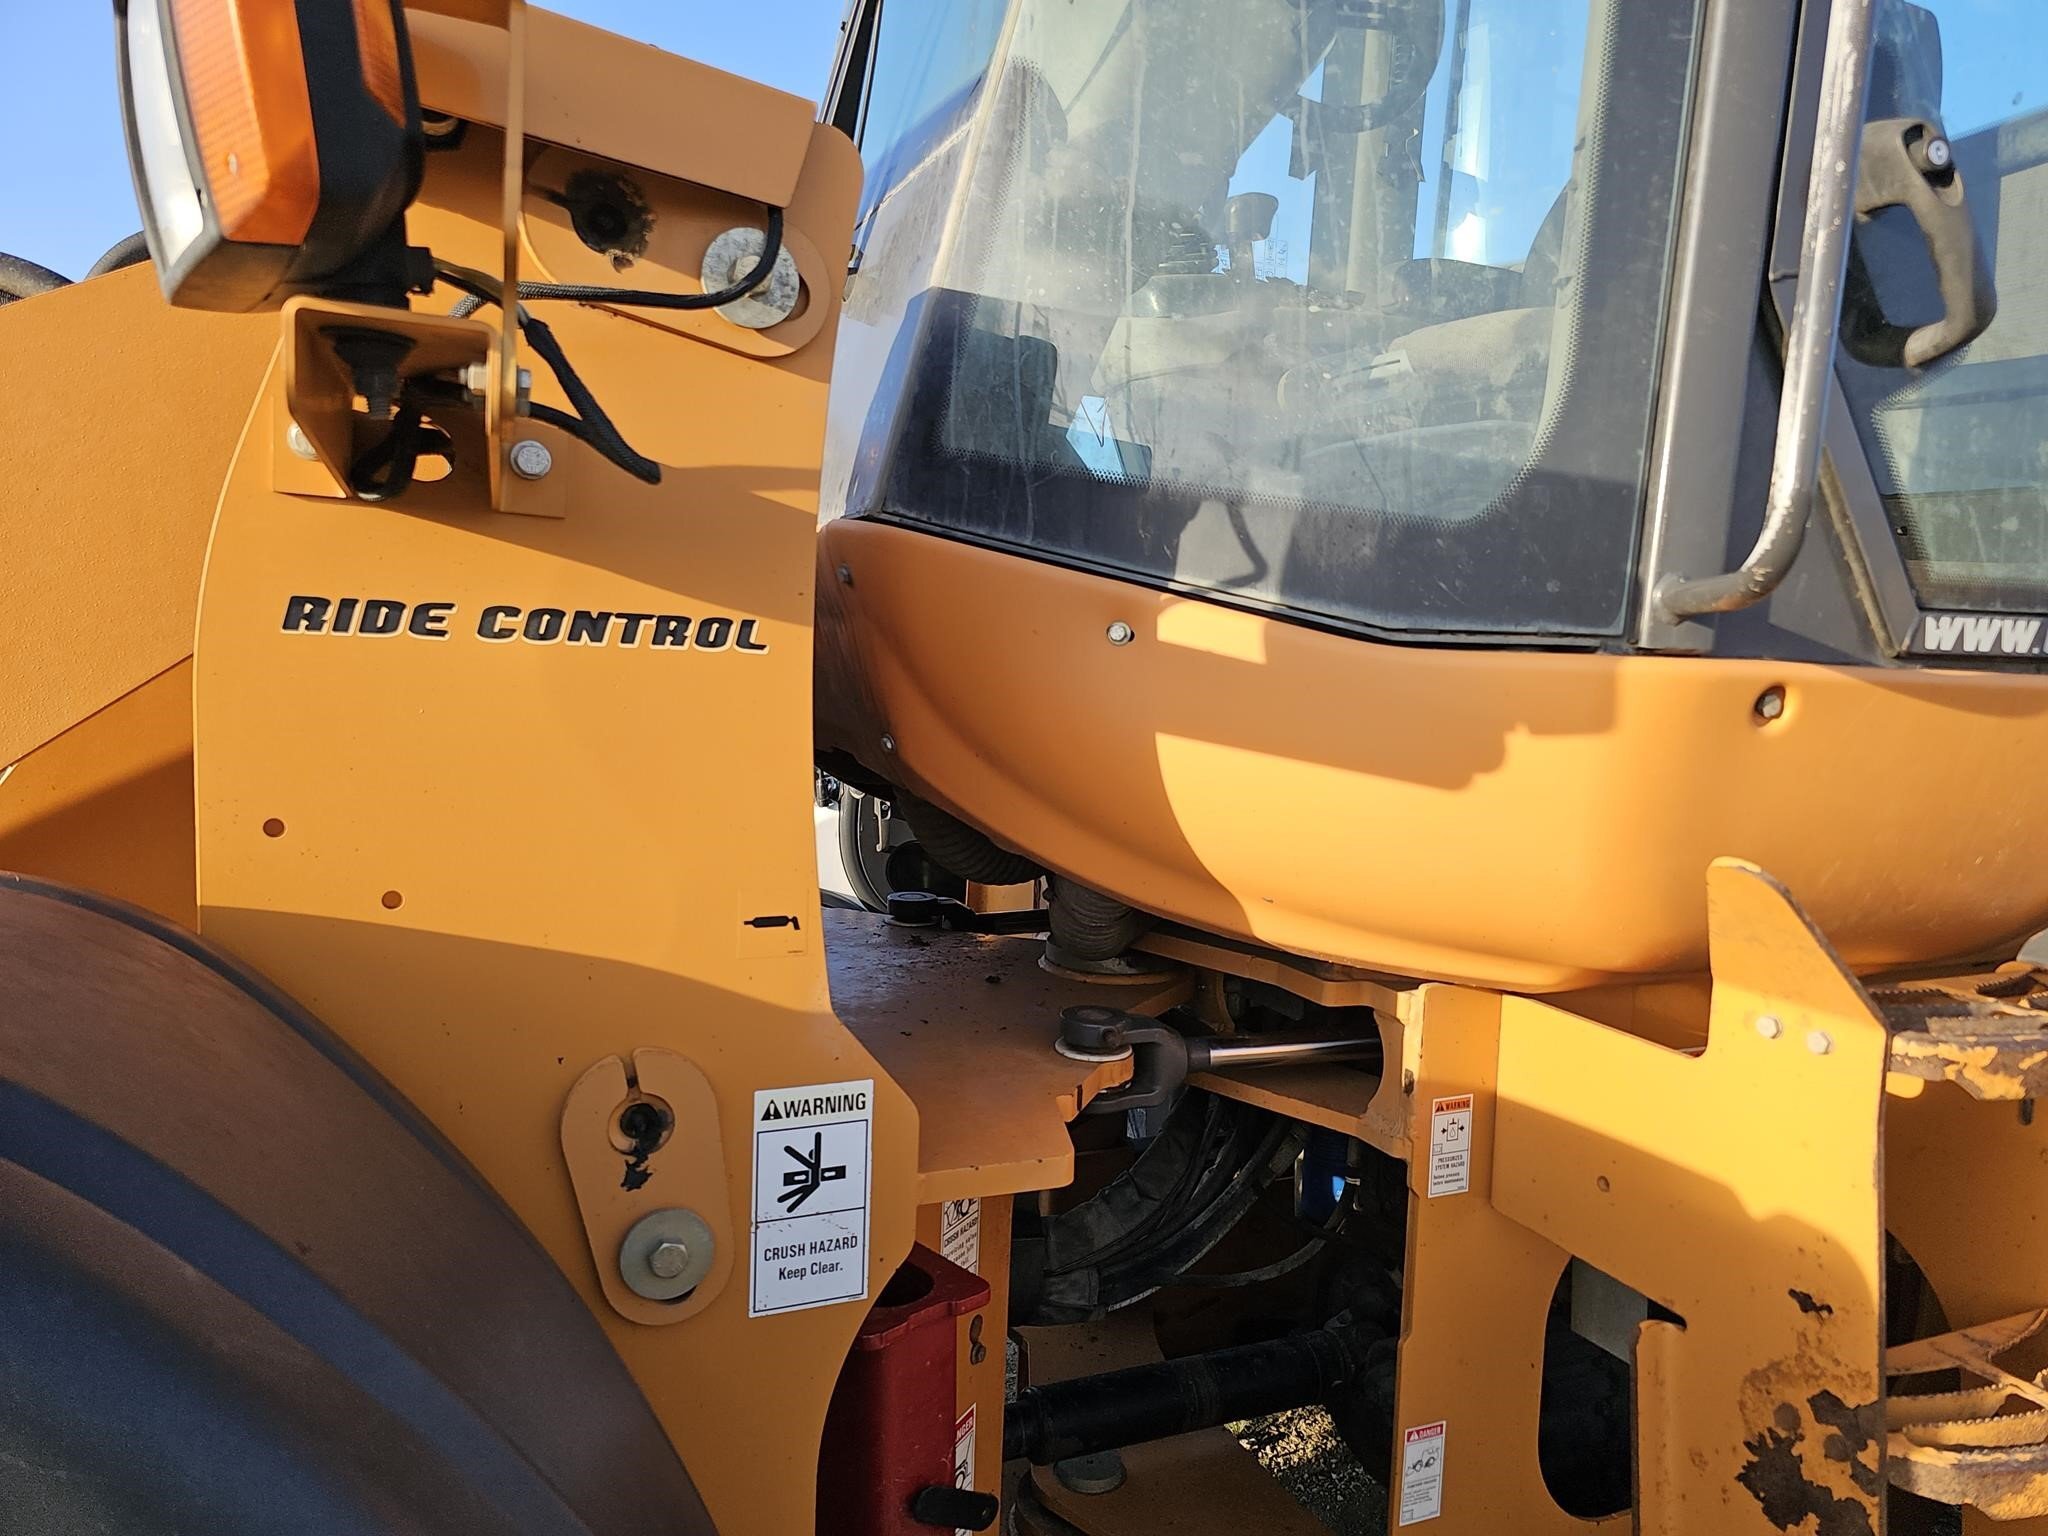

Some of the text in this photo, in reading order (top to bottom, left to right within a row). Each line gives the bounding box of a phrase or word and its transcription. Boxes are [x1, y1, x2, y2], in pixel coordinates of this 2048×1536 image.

[281, 595, 769, 654] RIDE CONTROL
[784, 1092, 866, 1119] WARNING
[1446, 1100, 1470, 1110] WARNING
[764, 1235, 858, 1262] CRUSH HAZARD
[779, 1261, 843, 1281] Keep Clear.
[956, 1416, 974, 1440] NGER
[1420, 1426, 1441, 1439] DANGER
